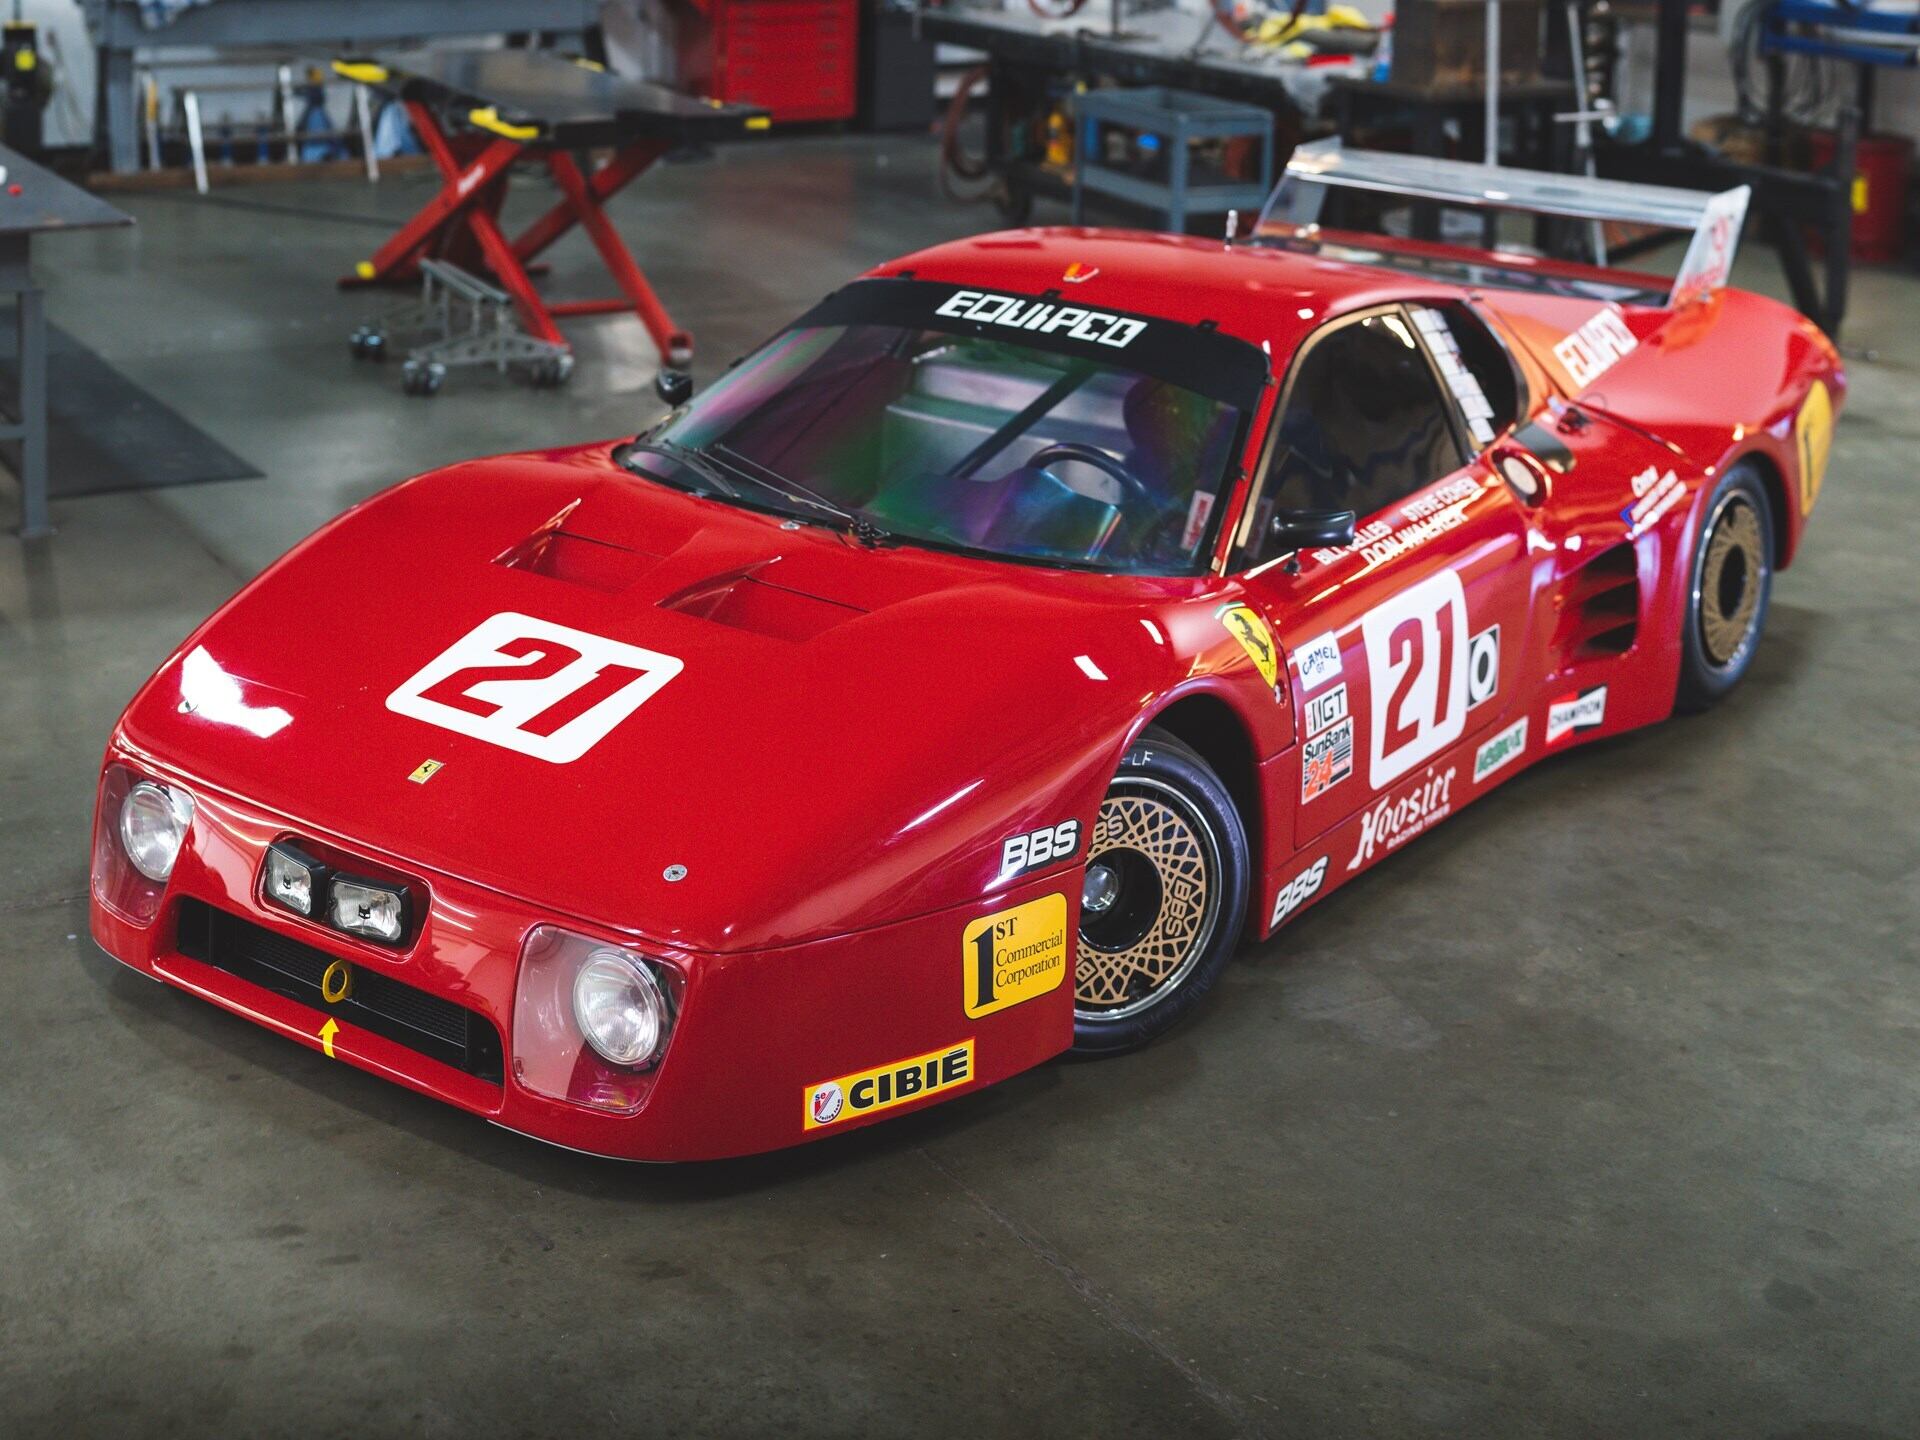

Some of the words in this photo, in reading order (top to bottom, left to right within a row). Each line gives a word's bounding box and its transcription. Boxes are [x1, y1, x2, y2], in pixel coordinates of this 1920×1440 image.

[935, 290, 1148, 348] EQUIPCO
[416, 637, 651, 738] 21
[1302, 646, 1337, 675] CAMEL
[1382, 599, 1453, 760] 21
[1132, 750, 1153, 766] LF
[1304, 721, 1351, 763] SunBank
[1305, 750, 1334, 798] 24
[1346, 766, 1456, 871] Hoosier
[1001, 819, 1079, 876] BBS
[1165, 880, 1192, 937] BBS
[1269, 855, 1329, 929] BBS
[995, 954, 1060, 988] Corporation
[996, 929, 1063, 967] Commercial
